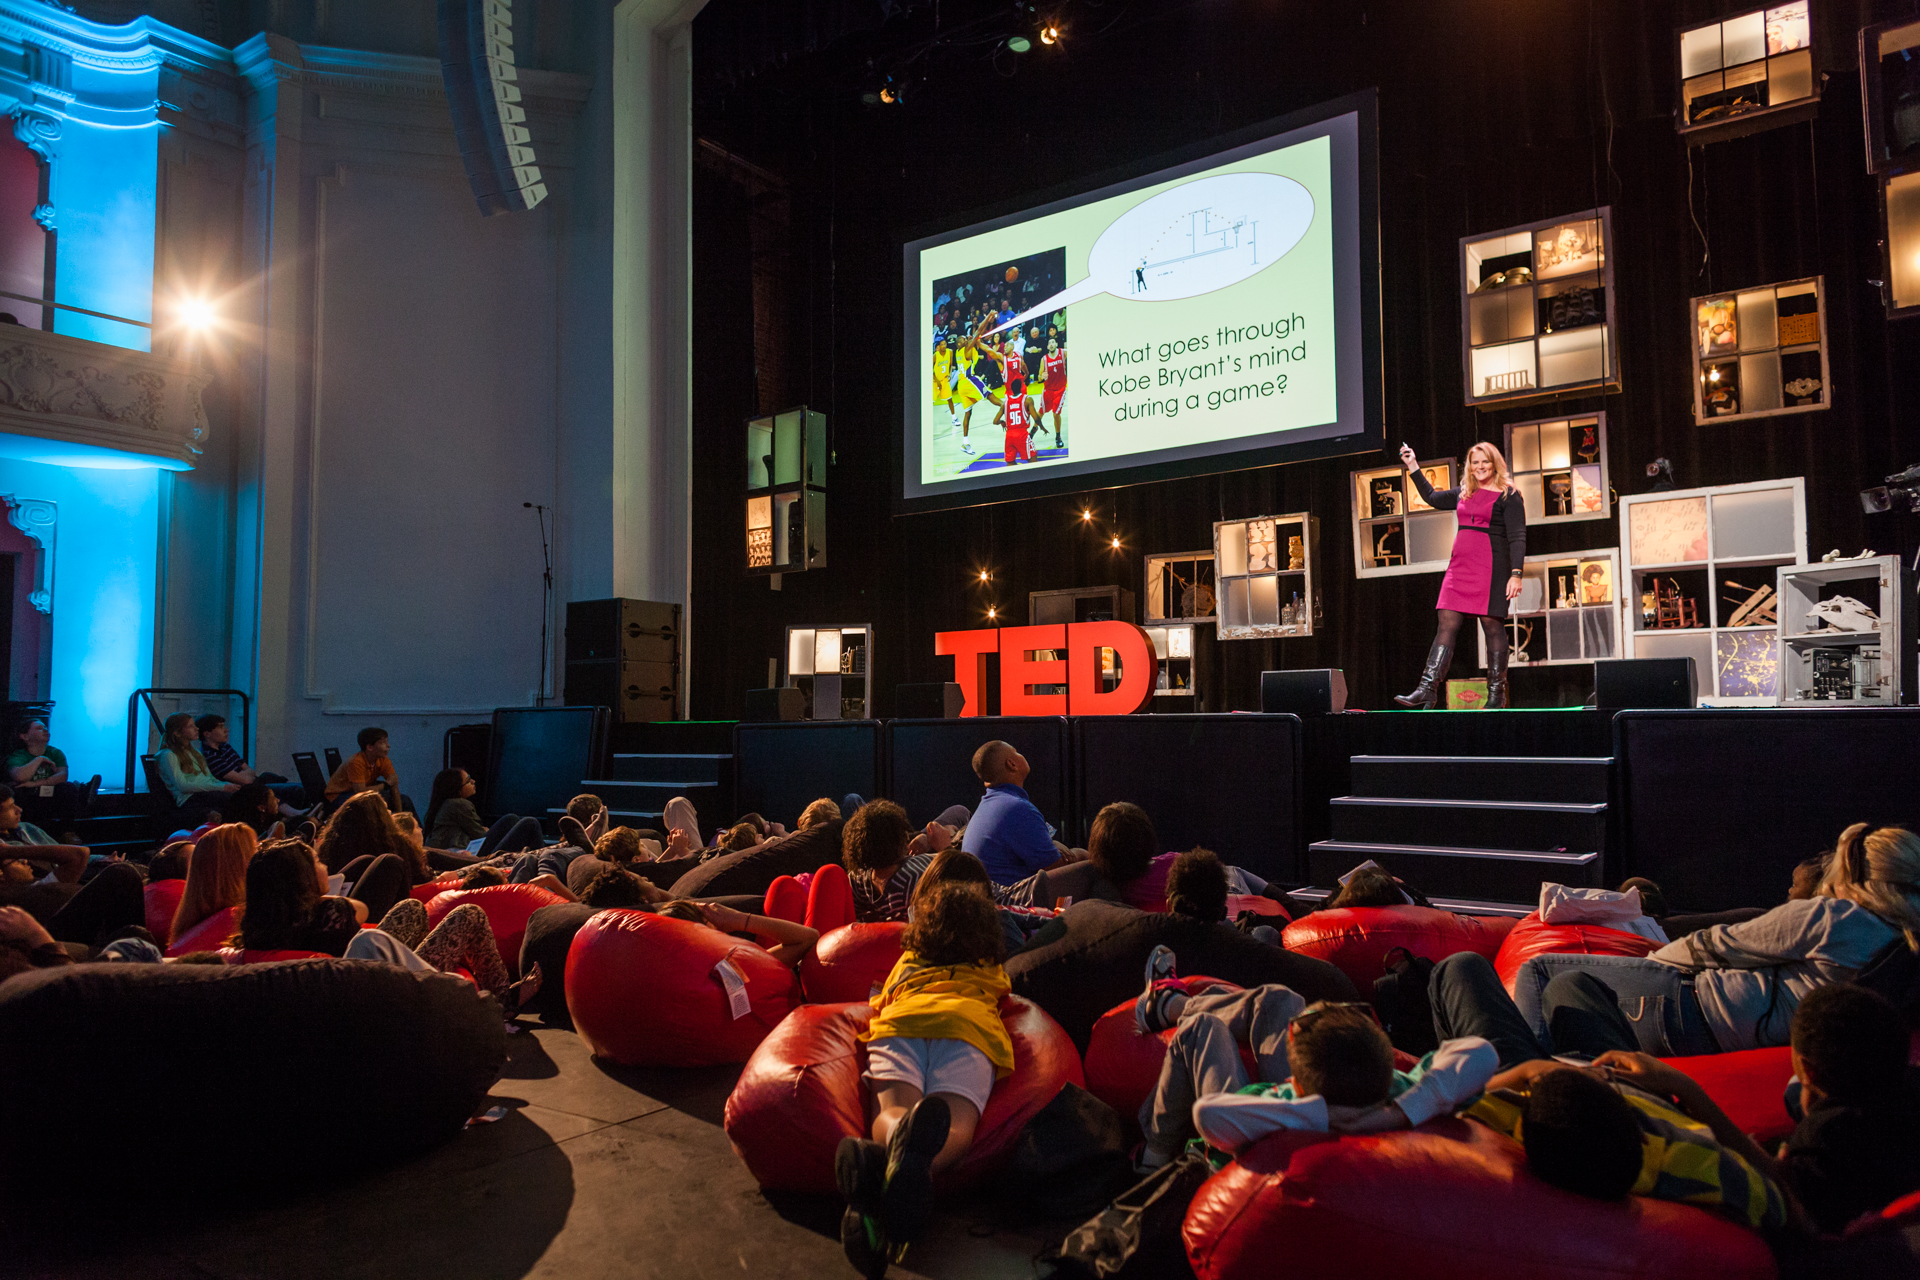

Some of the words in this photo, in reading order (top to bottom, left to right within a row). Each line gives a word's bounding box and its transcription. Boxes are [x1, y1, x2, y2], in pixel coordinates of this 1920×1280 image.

[1098, 343, 1151, 369] What
[1158, 335, 1209, 362] goes
[1216, 312, 1305, 347] through
[1099, 375, 1151, 397] Kobe
[1158, 354, 1242, 387] Bryant's
[1249, 340, 1306, 369] mind
[1009, 410, 1022, 426] 96
[1114, 398, 1179, 422] during
[1185, 394, 1199, 409] a
[1207, 374, 1288, 410] game?
[935, 620, 1157, 717] TED
